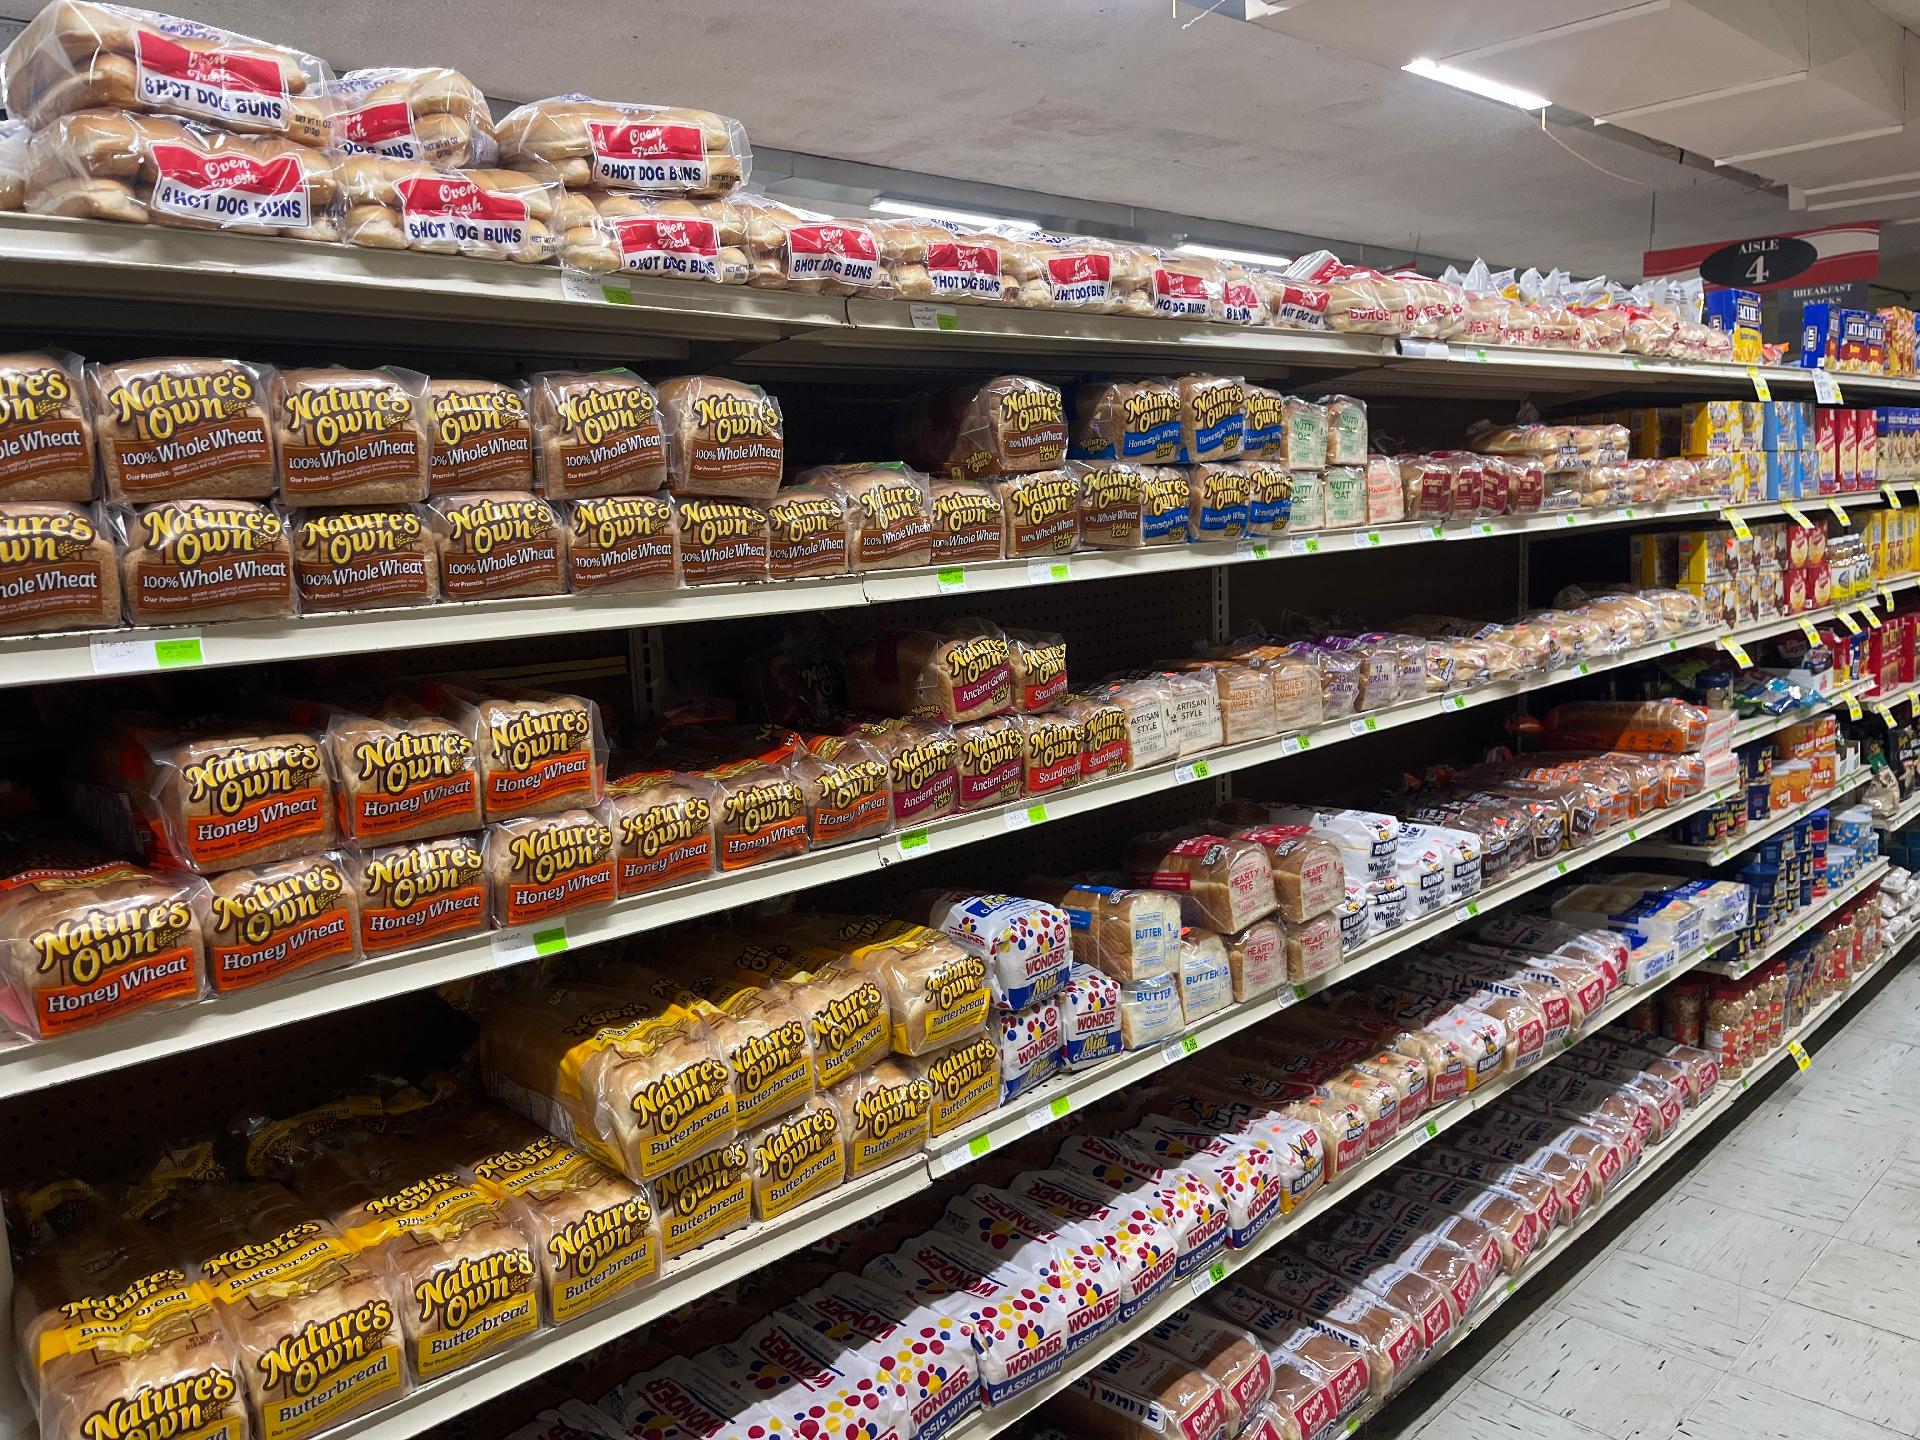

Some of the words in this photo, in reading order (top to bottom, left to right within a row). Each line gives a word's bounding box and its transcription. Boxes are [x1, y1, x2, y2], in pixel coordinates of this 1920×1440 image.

[155, 79, 191, 101] HOT
[196, 86, 231, 112] DOG
[236, 97, 282, 120] BUNS
[630, 125, 662, 144] Oven
[632, 140, 669, 156] Fresh
[205, 157, 250, 177] Oven
[211, 172, 259, 189] Fresh
[610, 162, 637, 181] HOT
[639, 164, 666, 181] DOG
[670, 164, 702, 181] BUNS
[161, 187, 171, 203] 8
[173, 188, 210, 213] HOT
[217, 194, 249, 217] DOG
[254, 198, 301, 218] BUNS
[439, 183, 477, 201] Oven
[419, 223, 446, 238] HOT
[483, 226, 522, 243] BUNS
[656, 220, 686, 236] Oven
[658, 232, 691, 248] Fresh
[1738, 239, 1780, 255] AISLE
[663, 256, 689, 274] DOG
[802, 259, 820, 273] HOT
[845, 264, 872, 280] BUNS
[1745, 255, 1770, 285] 4
[1793, 283, 1853, 299] BREAKFAST
[111, 371, 251, 422] Nature's
[287, 386, 411, 431] Nature's
[560, 389, 655, 431] Nature's
[1003, 390, 1063, 420] Nature's
[1126, 391, 1181, 421] Nature's
[150, 399, 224, 441] Own
[316, 407, 384, 447] Own
[585, 409, 638, 445] Own
[697, 394, 779, 432] Nature's
[1018, 410, 1051, 431] Own
[1139, 410, 1171, 432] Own
[1293, 420, 1316, 431] NUTTY
[20, 430, 81, 449] Wheat
[718, 415, 763, 444] Own
[1128, 433, 1162, 449] Homestyle
[1161, 428, 1180, 442] White
[121, 450, 158, 466] 100%
[158, 439, 210, 465] Whole
[210, 427, 264, 448] Wheat
[289, 456, 320, 469] 100%
[320, 447, 367, 468] Whole
[368, 440, 415, 460] Wheat
[566, 454, 590, 467] 100%
[590, 443, 627, 464] Whole
[626, 434, 661, 452] Wheat
[716, 446, 748, 462] Whole
[748, 447, 782, 461] Wheat
[1040, 446, 1060, 455] SMALL
[1040, 451, 1058, 461] LOAF
[125, 473, 140, 481] Our
[1329, 481, 1355, 491] NUTTY
[1334, 491, 1351, 500] OAT
[145, 507, 281, 550] Nature's
[450, 499, 551, 536] Nature's
[576, 499, 671, 533] Nature's
[176, 528, 253, 566] Own
[474, 521, 530, 554] Own
[600, 520, 650, 548] Own
[142, 575, 179, 590] 100%
[179, 568, 233, 589] Whole
[233, 561, 286, 579] Wheat
[448, 562, 477, 576] 100%
[476, 554, 517, 575] Whole
[516, 548, 556, 566] Wheat
[1368, 674, 1389, 684] GRAIN
[1375, 665, 1383, 673] 12
[963, 681, 991, 702] Ancient
[1176, 699, 1207, 713] ARTISAN
[1229, 690, 1260, 701] HONEY
[1130, 710, 1160, 726] ARTISAN
[1136, 722, 1158, 735] STYLE
[1181, 709, 1203, 721] STYLE
[491, 711, 588, 757] Nature's
[357, 734, 475, 778] Nature's
[512, 733, 569, 770] Own
[184, 744, 320, 800] Nature's
[385, 756, 453, 793] Own
[972, 776, 1001, 793] Ancient
[1002, 765, 1020, 783] Grain
[1039, 761, 1080, 784] Sourdough
[219, 767, 291, 812] Own
[364, 794, 420, 817] Honey
[422, 780, 471, 803] Wheat
[197, 814, 260, 841] Honey
[260, 798, 318, 823] Wheat
[1231, 867, 1260, 888] HEARTY
[1304, 862, 1331, 879] HEARTY
[1310, 874, 1324, 885] RYE
[210, 865, 343, 931] Nature's
[1240, 881, 1255, 892] RYE
[1378, 887, 1407, 904] BUNNY
[245, 894, 319, 944] Own
[1135, 927, 1163, 940] BUTTER
[32, 900, 191, 974] Nature's
[223, 945, 287, 970] Honey
[288, 919, 345, 949] Wheat
[71, 930, 157, 985] Own
[1025, 950, 1065, 972] WONDER
[48, 985, 120, 1014] Honey
[120, 957, 187, 988] Wheat
[1034, 967, 1059, 996] Mini
[1137, 989, 1173, 1002] BUTTER
[1077, 1010, 1116, 1030] WONDER
[1084, 1029, 1108, 1052] Mini
[631, 1059, 729, 1129] Nature's
[660, 1087, 713, 1132] Own
[650, 1102, 731, 1156] Butterbread
[757, 1108, 837, 1175] Nature's
[777, 1136, 824, 1182] Own
[770, 1151, 837, 1202] Butterbread
[1292, 1166, 1324, 1194] BUNNY
[1187, 1215, 1229, 1249] WONDER
[1180, 1244, 1211, 1270] CLASSIC
[1132, 1253, 1177, 1296] WONDER
[1124, 1287, 1158, 1319] CLASSIC
[259, 1299, 393, 1389] Nature's
[293, 1340, 367, 1397] Own
[278, 1356, 388, 1423] Butterbread
[1101, 1389, 1159, 1424] WHITE
[1193, 1397, 1217, 1429] Oven
